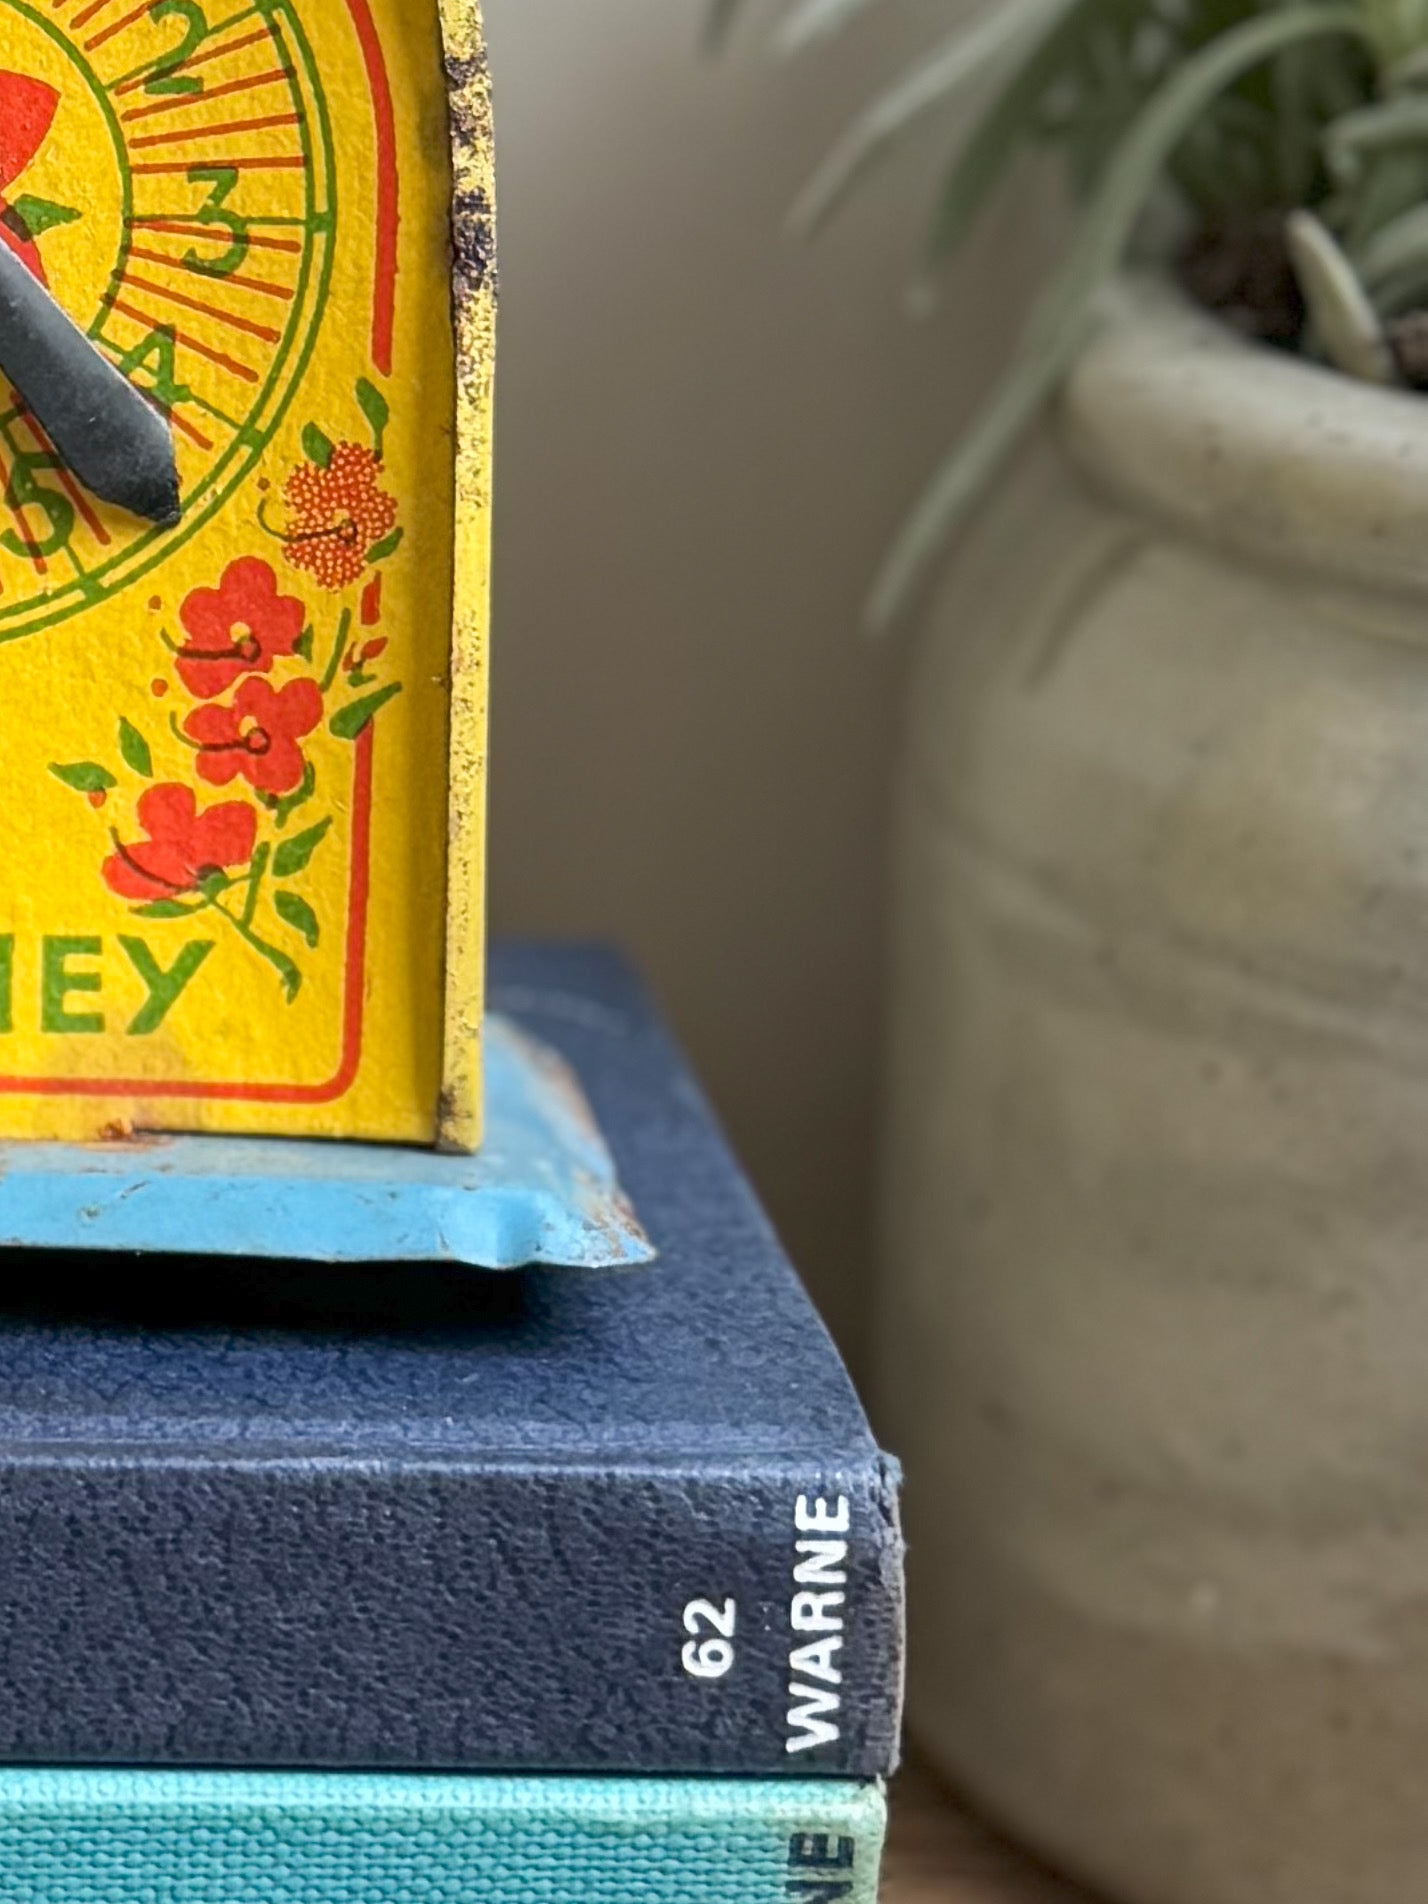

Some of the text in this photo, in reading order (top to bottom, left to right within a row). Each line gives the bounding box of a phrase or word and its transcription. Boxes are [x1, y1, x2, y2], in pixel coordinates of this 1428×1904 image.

[181, 165, 248, 277] 3
[0, 452, 74, 558] 5
[681, 1598, 736, 1679] 62
[785, 1493, 851, 1755] WARNE
